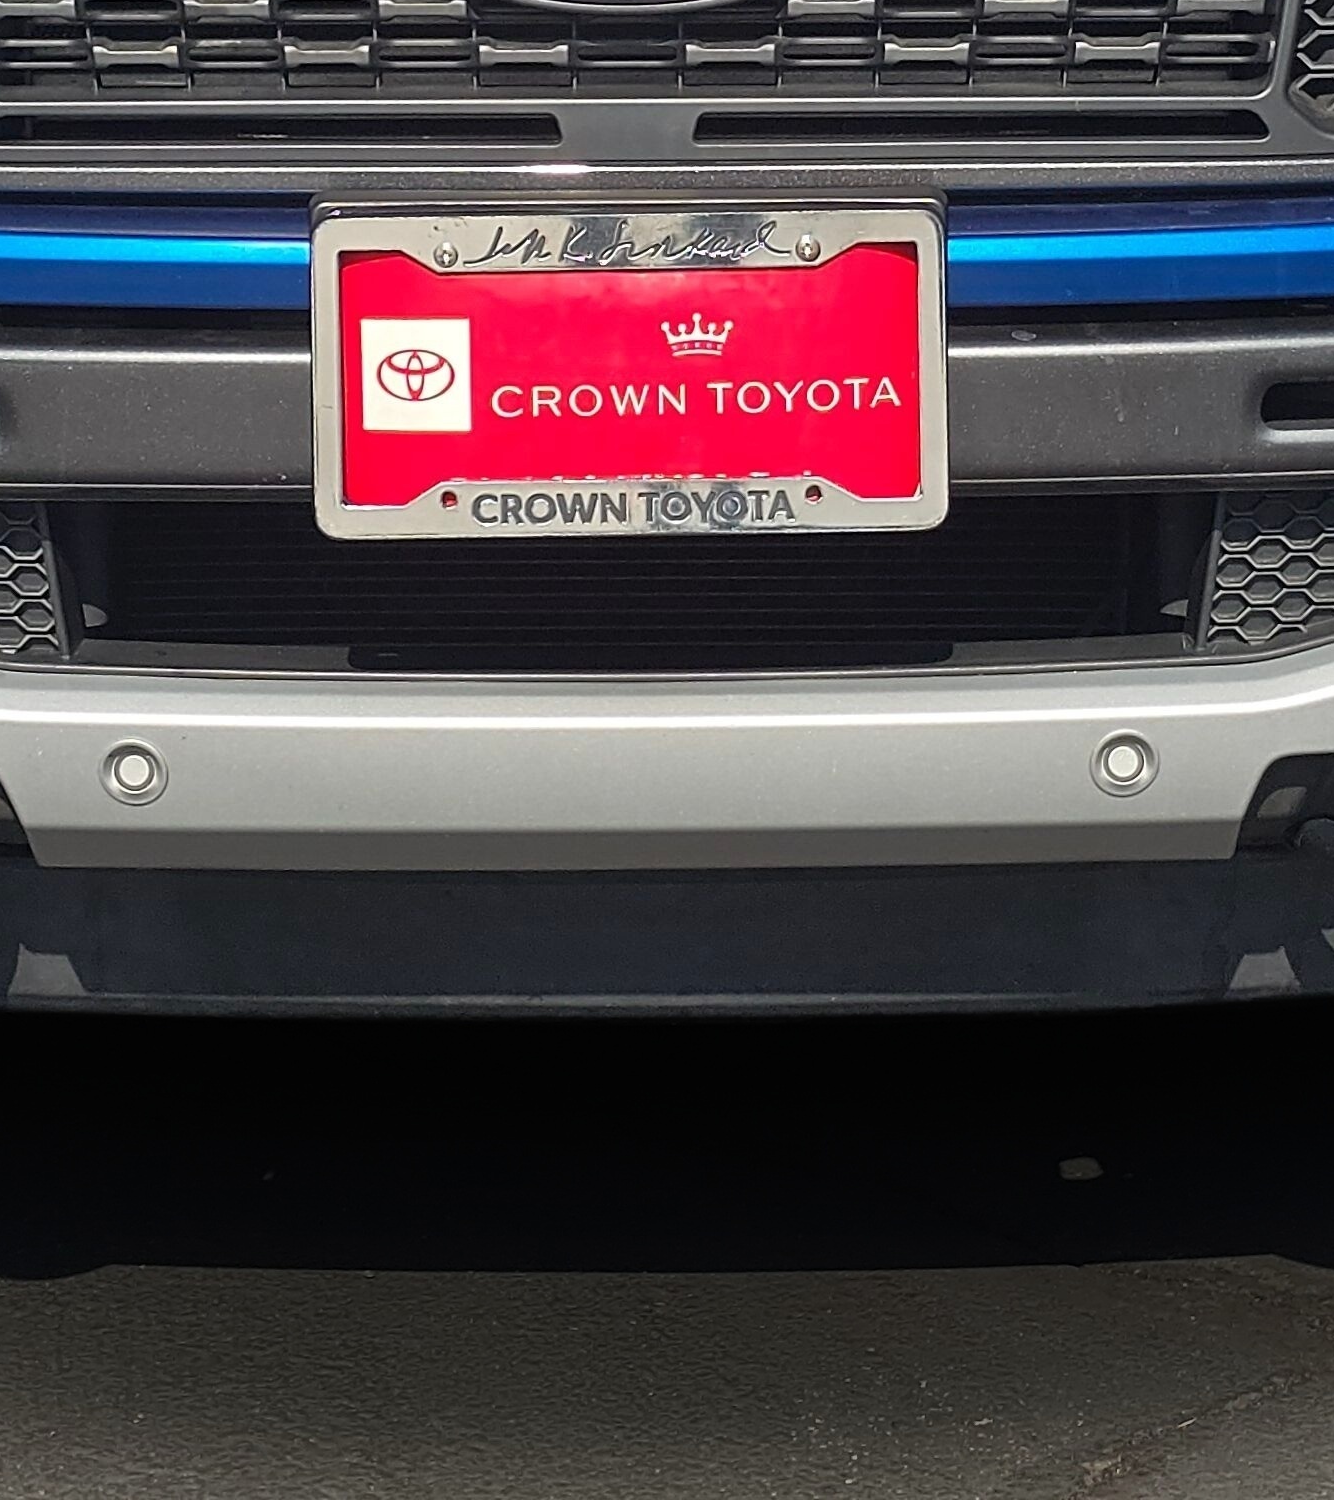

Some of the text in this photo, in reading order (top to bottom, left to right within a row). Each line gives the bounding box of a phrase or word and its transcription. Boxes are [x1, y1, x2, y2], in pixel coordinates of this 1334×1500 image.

[491, 376, 901, 418] CROWN TOYOTA
[471, 488, 796, 525] CROWN TOYOTA
